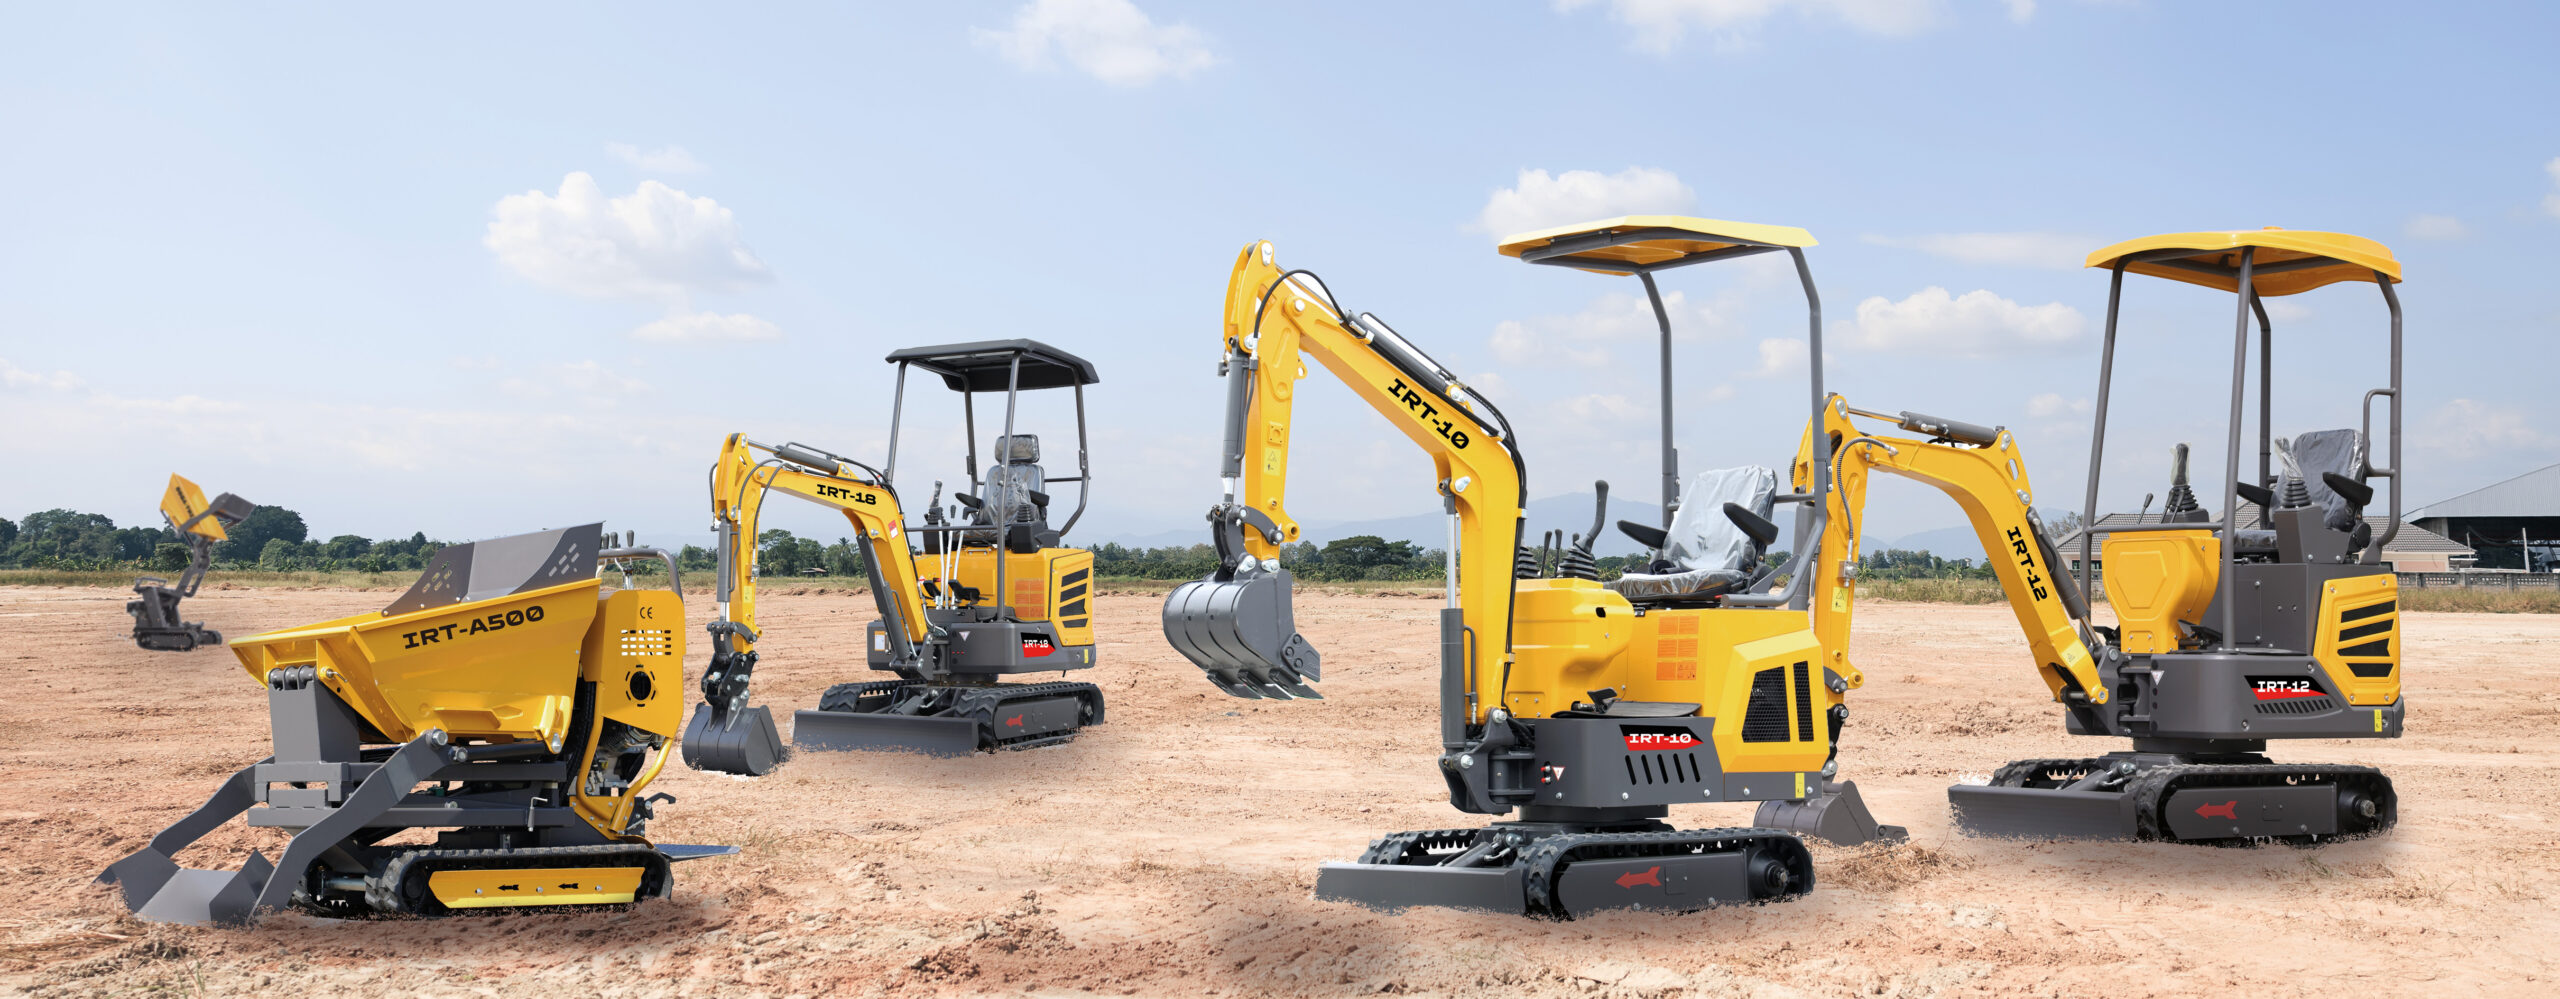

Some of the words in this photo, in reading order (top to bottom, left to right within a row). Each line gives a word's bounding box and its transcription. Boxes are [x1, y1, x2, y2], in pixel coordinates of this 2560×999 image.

[1387, 377, 1470, 449] IRT-10
[816, 483, 877, 506] IRT-18
[2006, 526, 2048, 602] IRT-12
[639, 606, 653, 619] CE
[402, 605, 545, 650] IRT-A500
[1023, 639, 1049, 649] IRT-18
[2257, 680, 2310, 693] IRT-12
[1629, 733, 1692, 744] IRT-10
